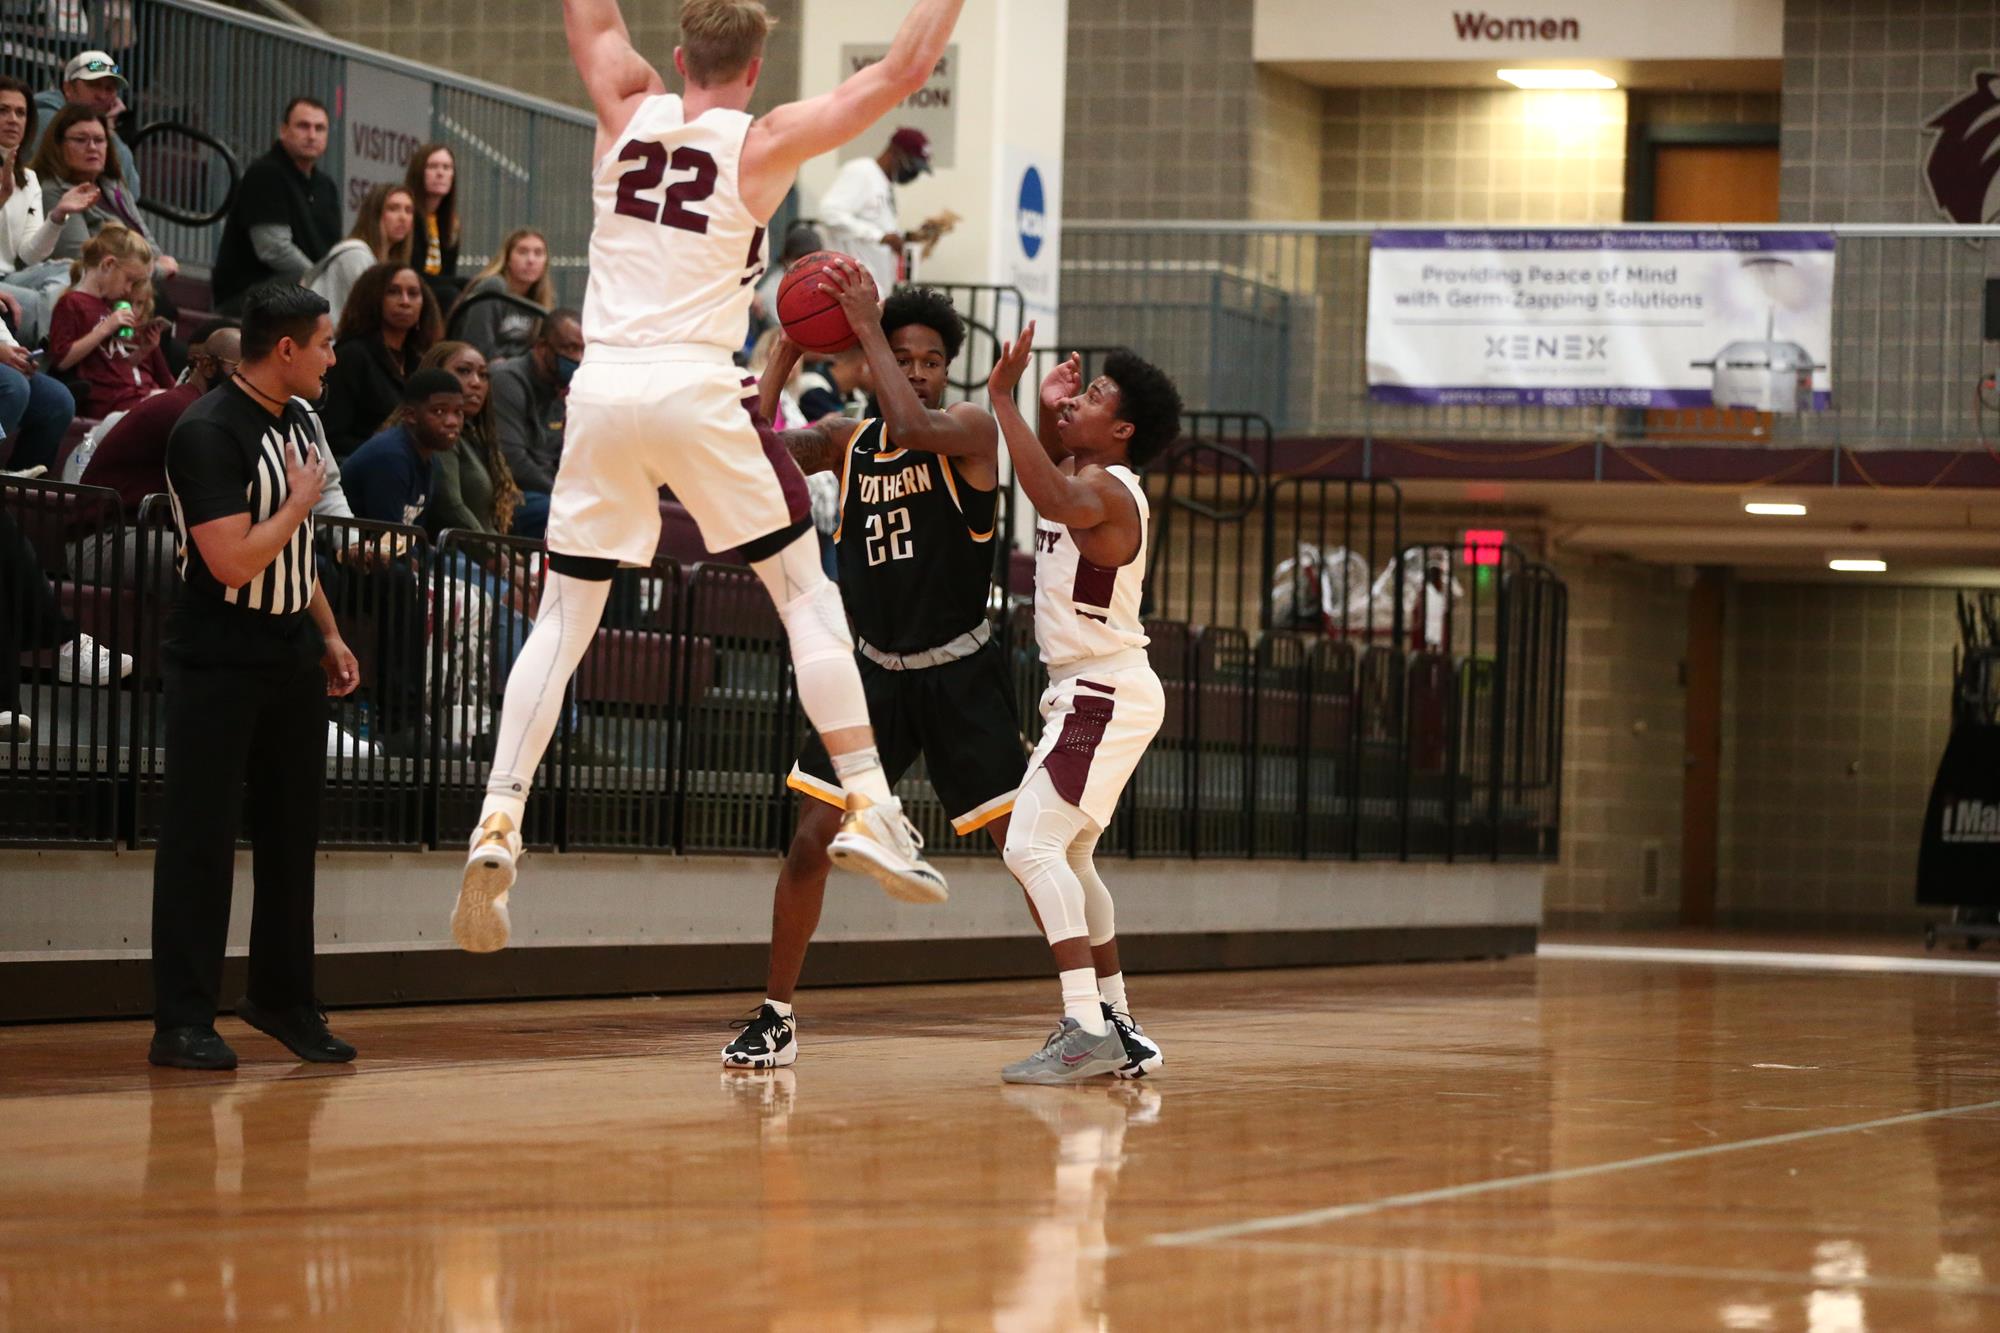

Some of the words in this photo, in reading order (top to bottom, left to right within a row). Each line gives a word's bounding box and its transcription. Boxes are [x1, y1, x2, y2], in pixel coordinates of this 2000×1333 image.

[1453, 11, 1579, 41] Women
[614, 138, 718, 235] 22
[1422, 265, 1521, 286] Providing
[1529, 266, 1591, 284] Peace
[1597, 265, 1618, 284] of
[1627, 266, 1677, 284] Mind
[1395, 290, 1440, 307] with
[1605, 290, 1703, 309] Solutions
[1484, 335, 1607, 360] XENEX
[865, 507, 914, 566] 22
